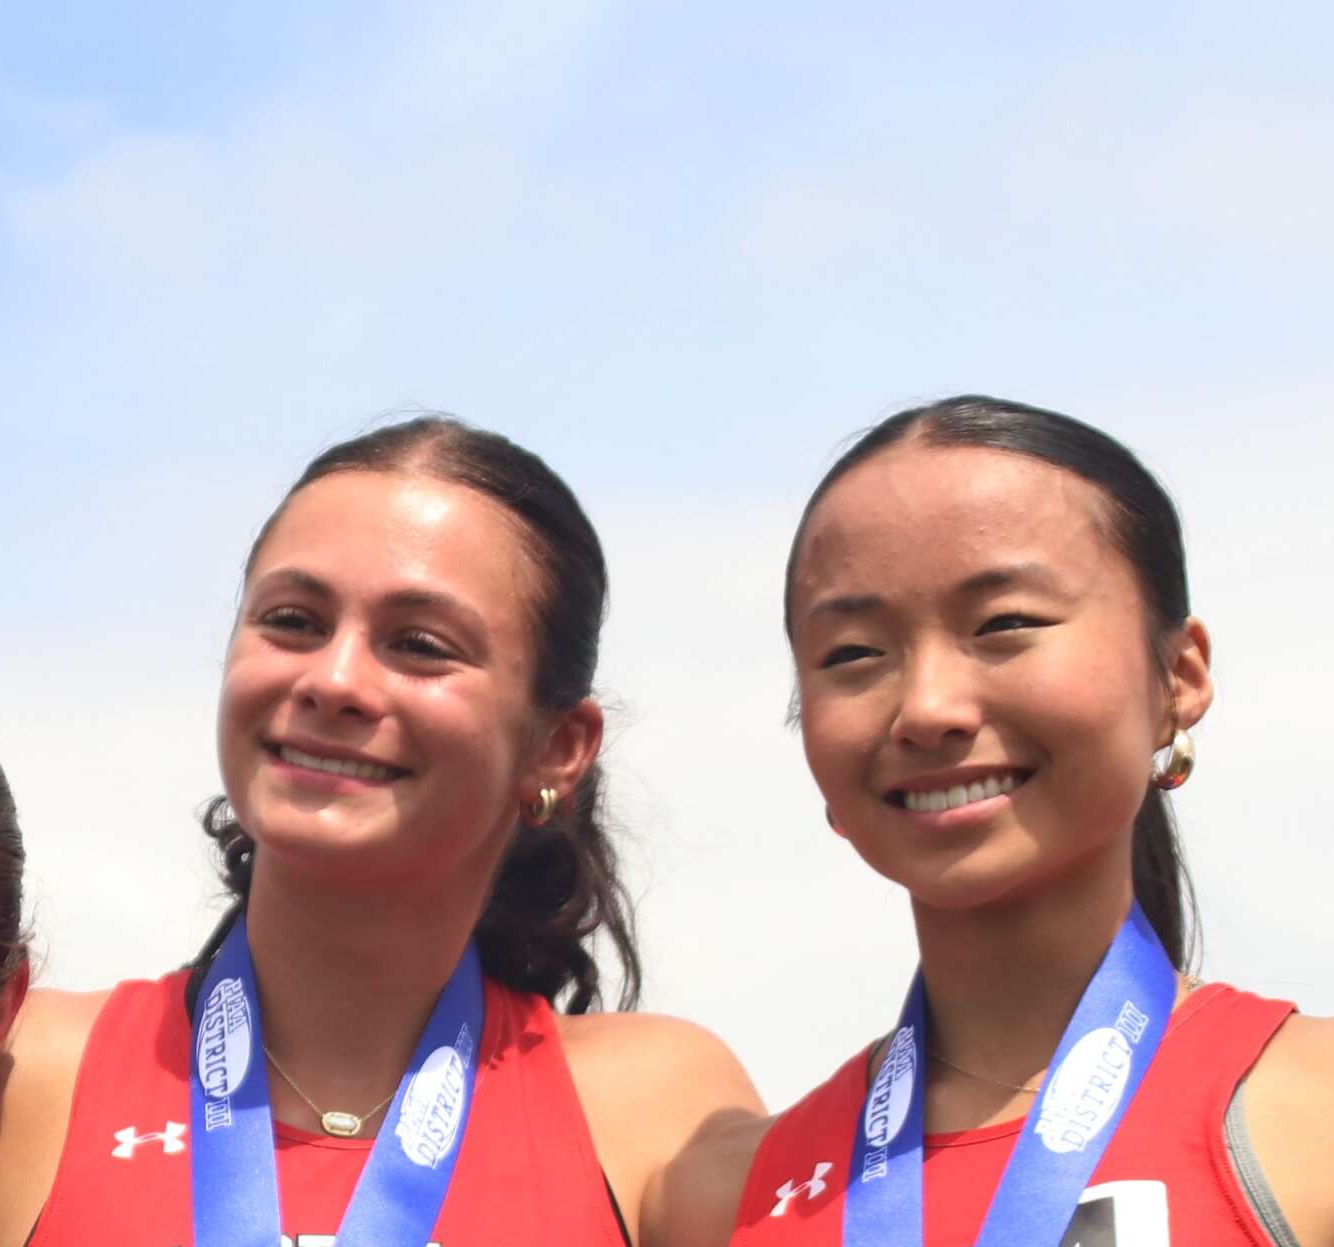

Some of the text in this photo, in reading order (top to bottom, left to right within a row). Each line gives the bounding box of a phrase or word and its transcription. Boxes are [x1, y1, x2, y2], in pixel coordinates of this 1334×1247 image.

[204, 993, 229, 1098] DISTRICT
[1062, 1034, 1133, 1150] DISTRICT
[417, 1050, 468, 1169] DISTRICT
